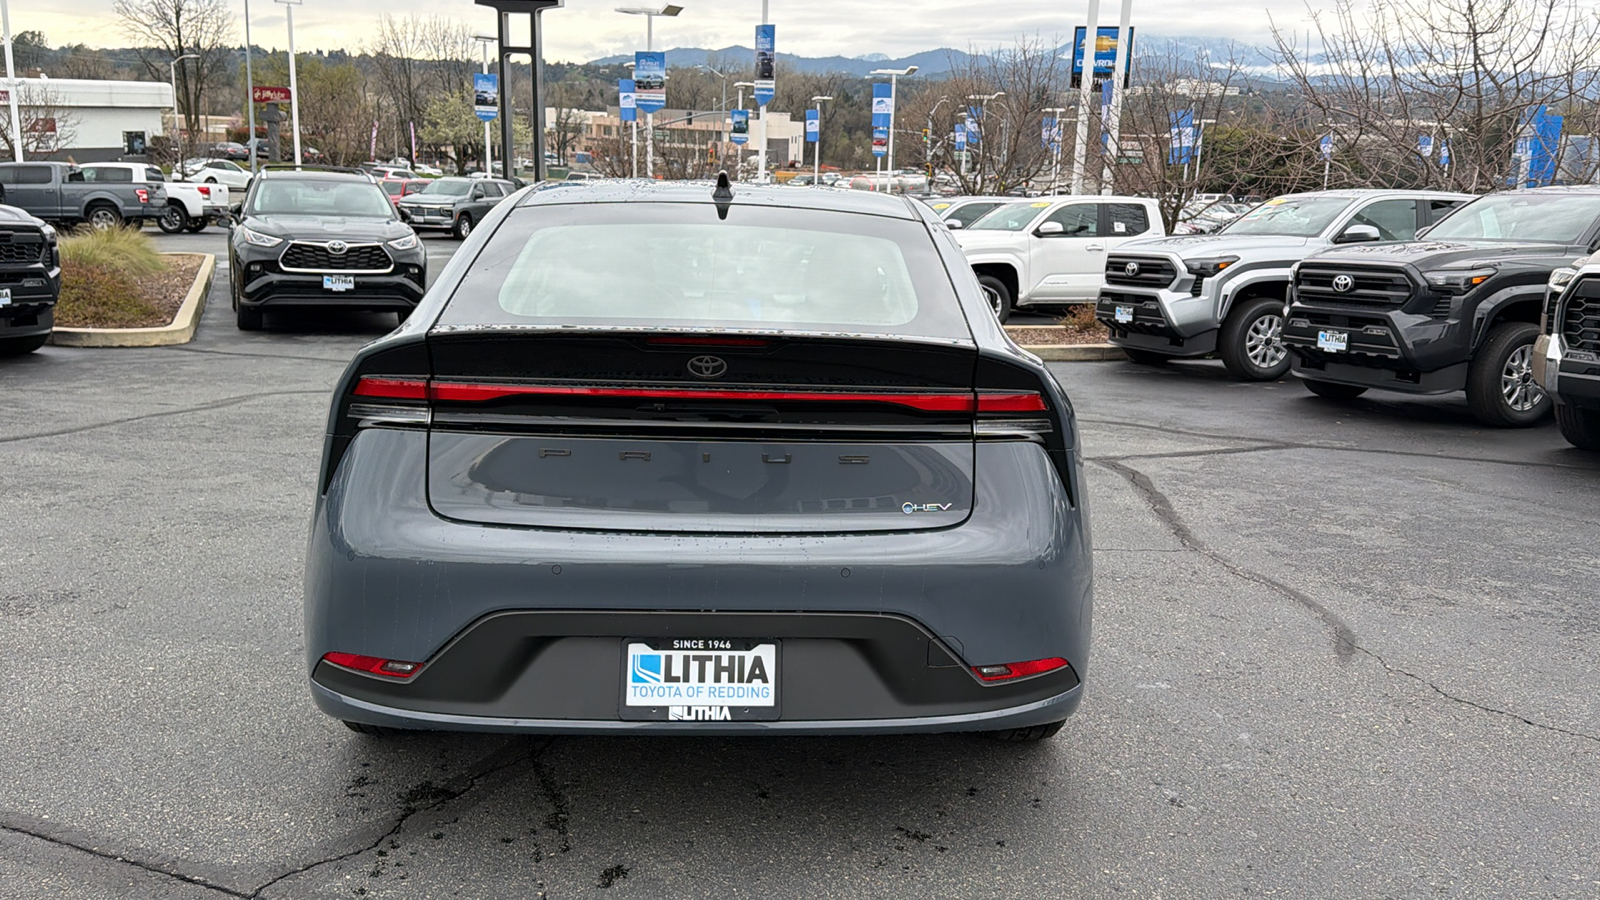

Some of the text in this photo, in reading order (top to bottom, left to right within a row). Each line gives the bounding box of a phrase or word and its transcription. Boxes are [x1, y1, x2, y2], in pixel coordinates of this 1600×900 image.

[1325, 334, 1347, 343] LITHIA
[539, 448, 870, 464] PRIUS
[673, 640, 732, 649] SINCE 1946
[664, 654, 769, 683] LITHIA
[631, 686, 770, 698] TOYOTA OF REDDING
[683, 706, 732, 721] LITHIA
